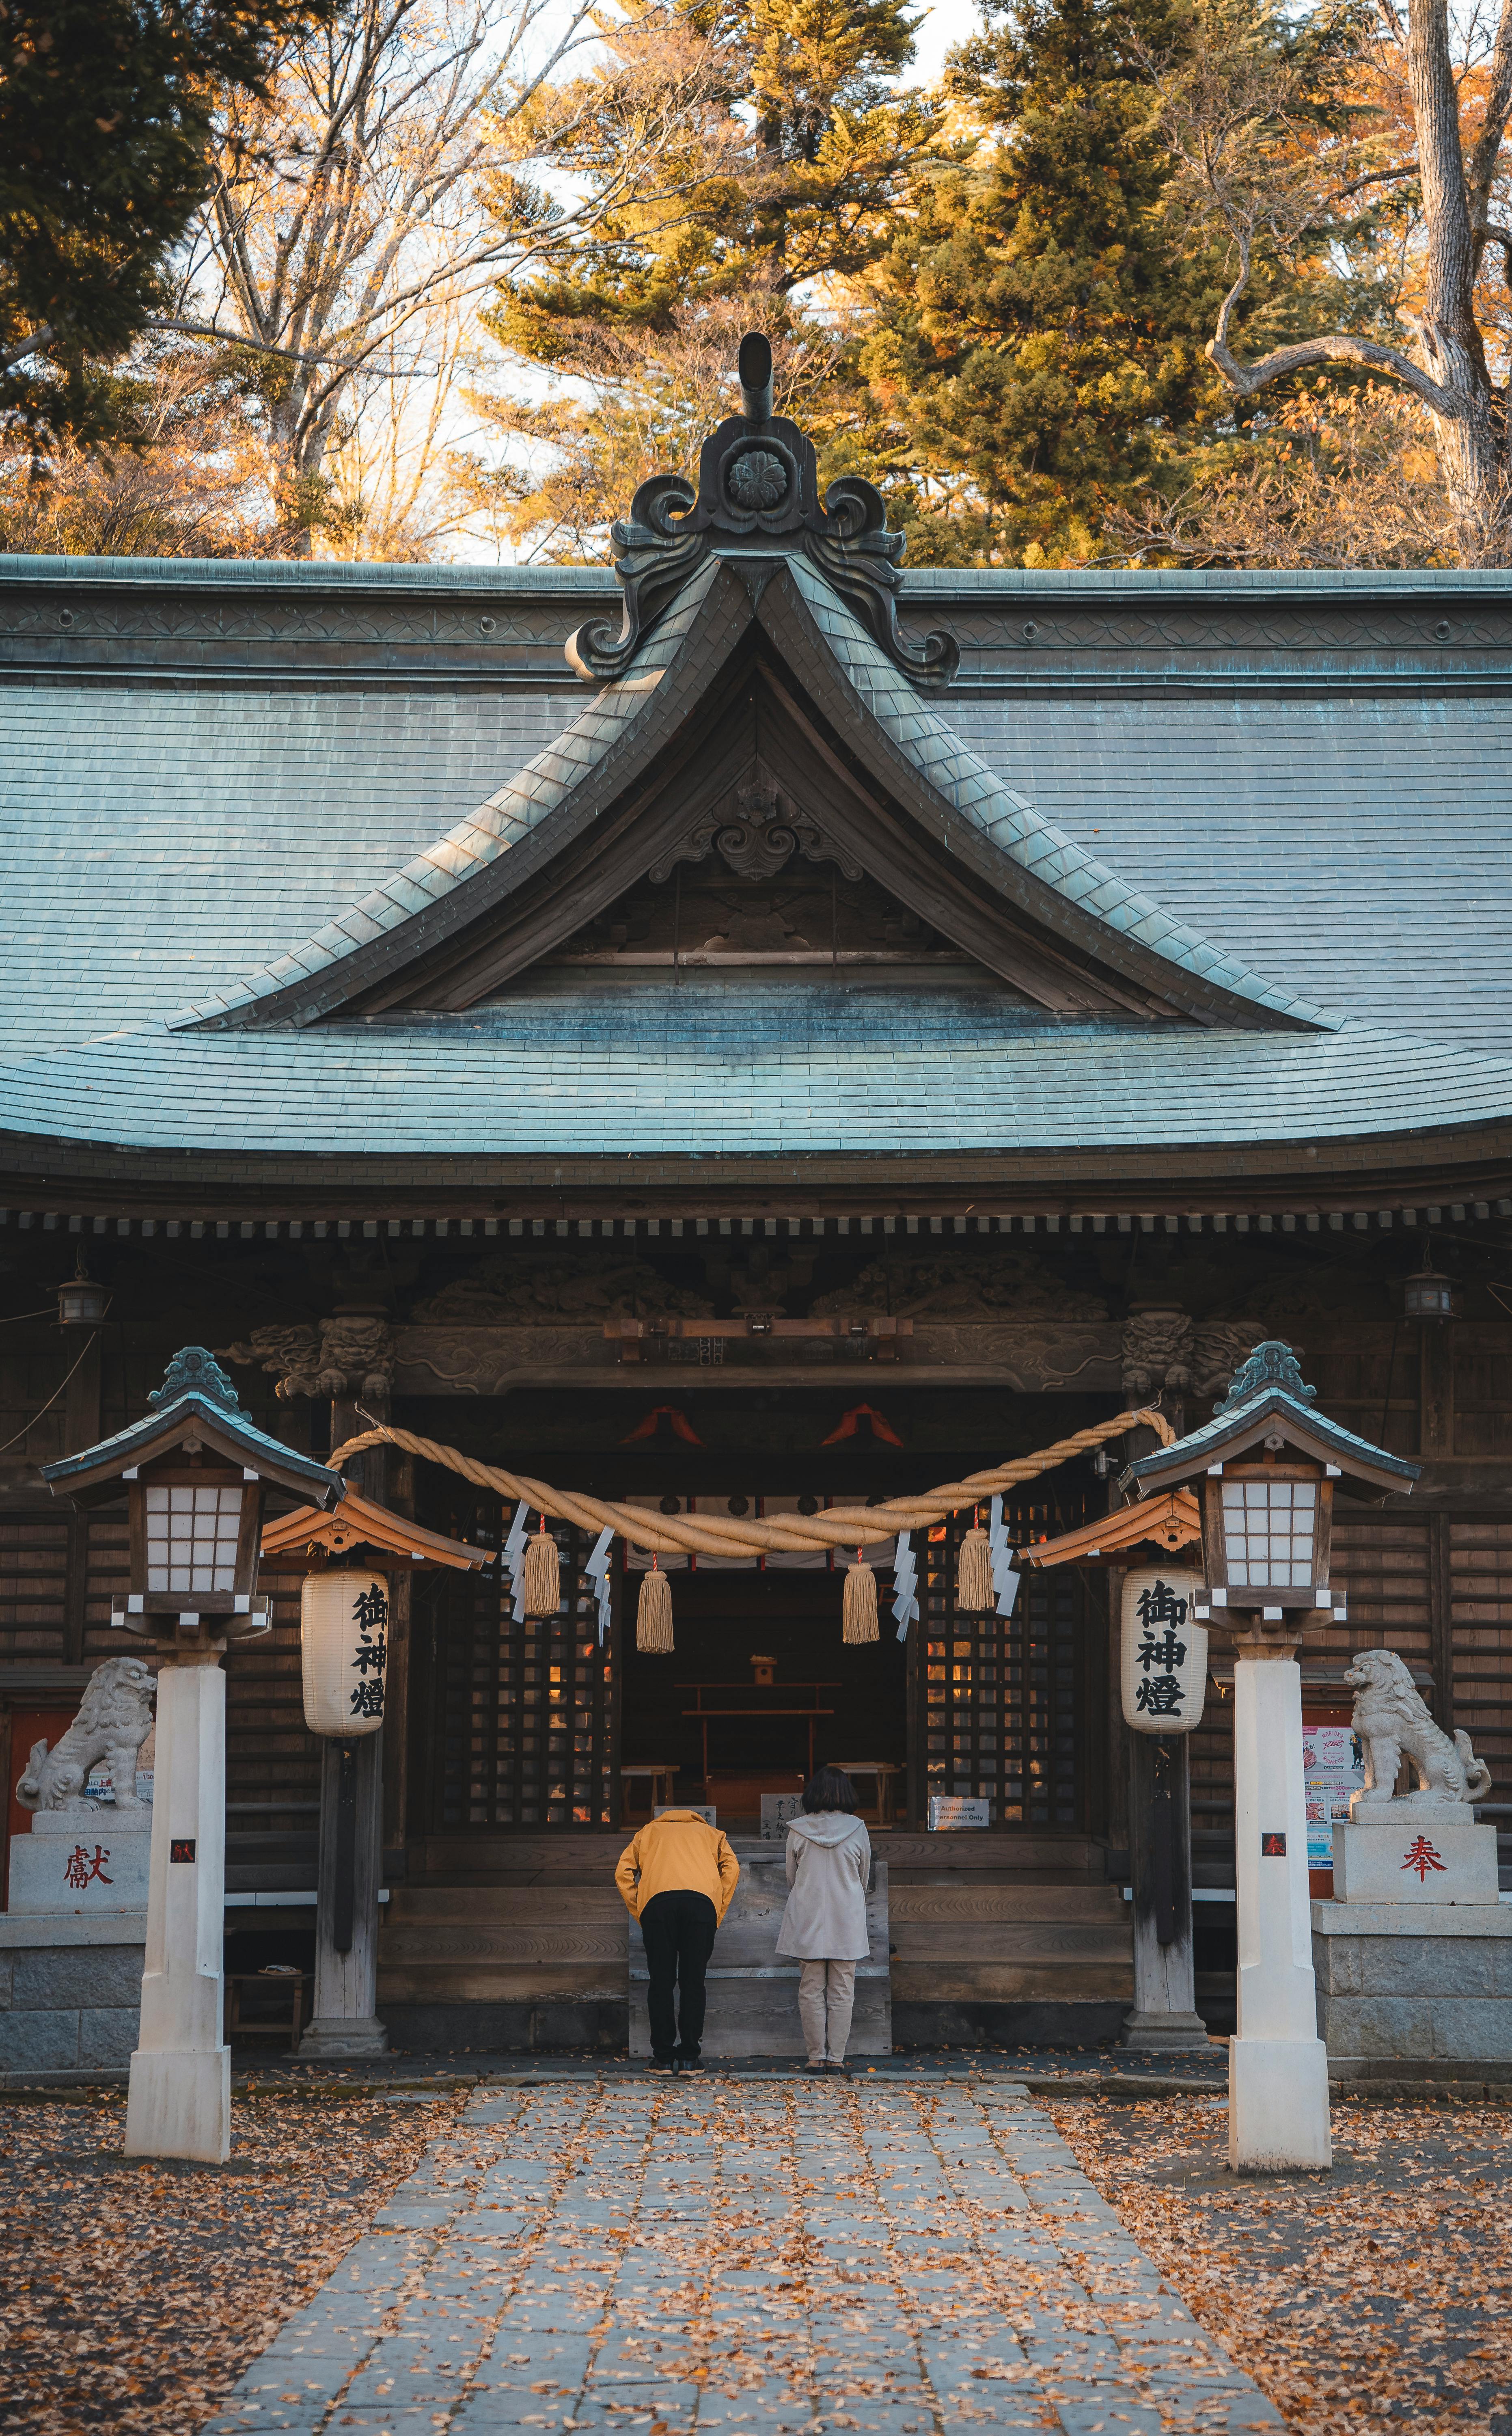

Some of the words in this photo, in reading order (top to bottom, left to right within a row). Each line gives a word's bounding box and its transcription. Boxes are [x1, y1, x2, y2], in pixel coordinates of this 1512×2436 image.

[350, 1583, 388, 1719] 御神燈
[1135, 1580, 1188, 1717] 御神燈
[1321, 1731, 1344, 1739] MORIOKA
[1322, 1756, 1345, 1765] MOMBETSU
[788, 1796, 799, 1821] 守り
[1264, 1835, 1285, 1854] 奉
[1399, 1835, 1448, 1883] 奉
